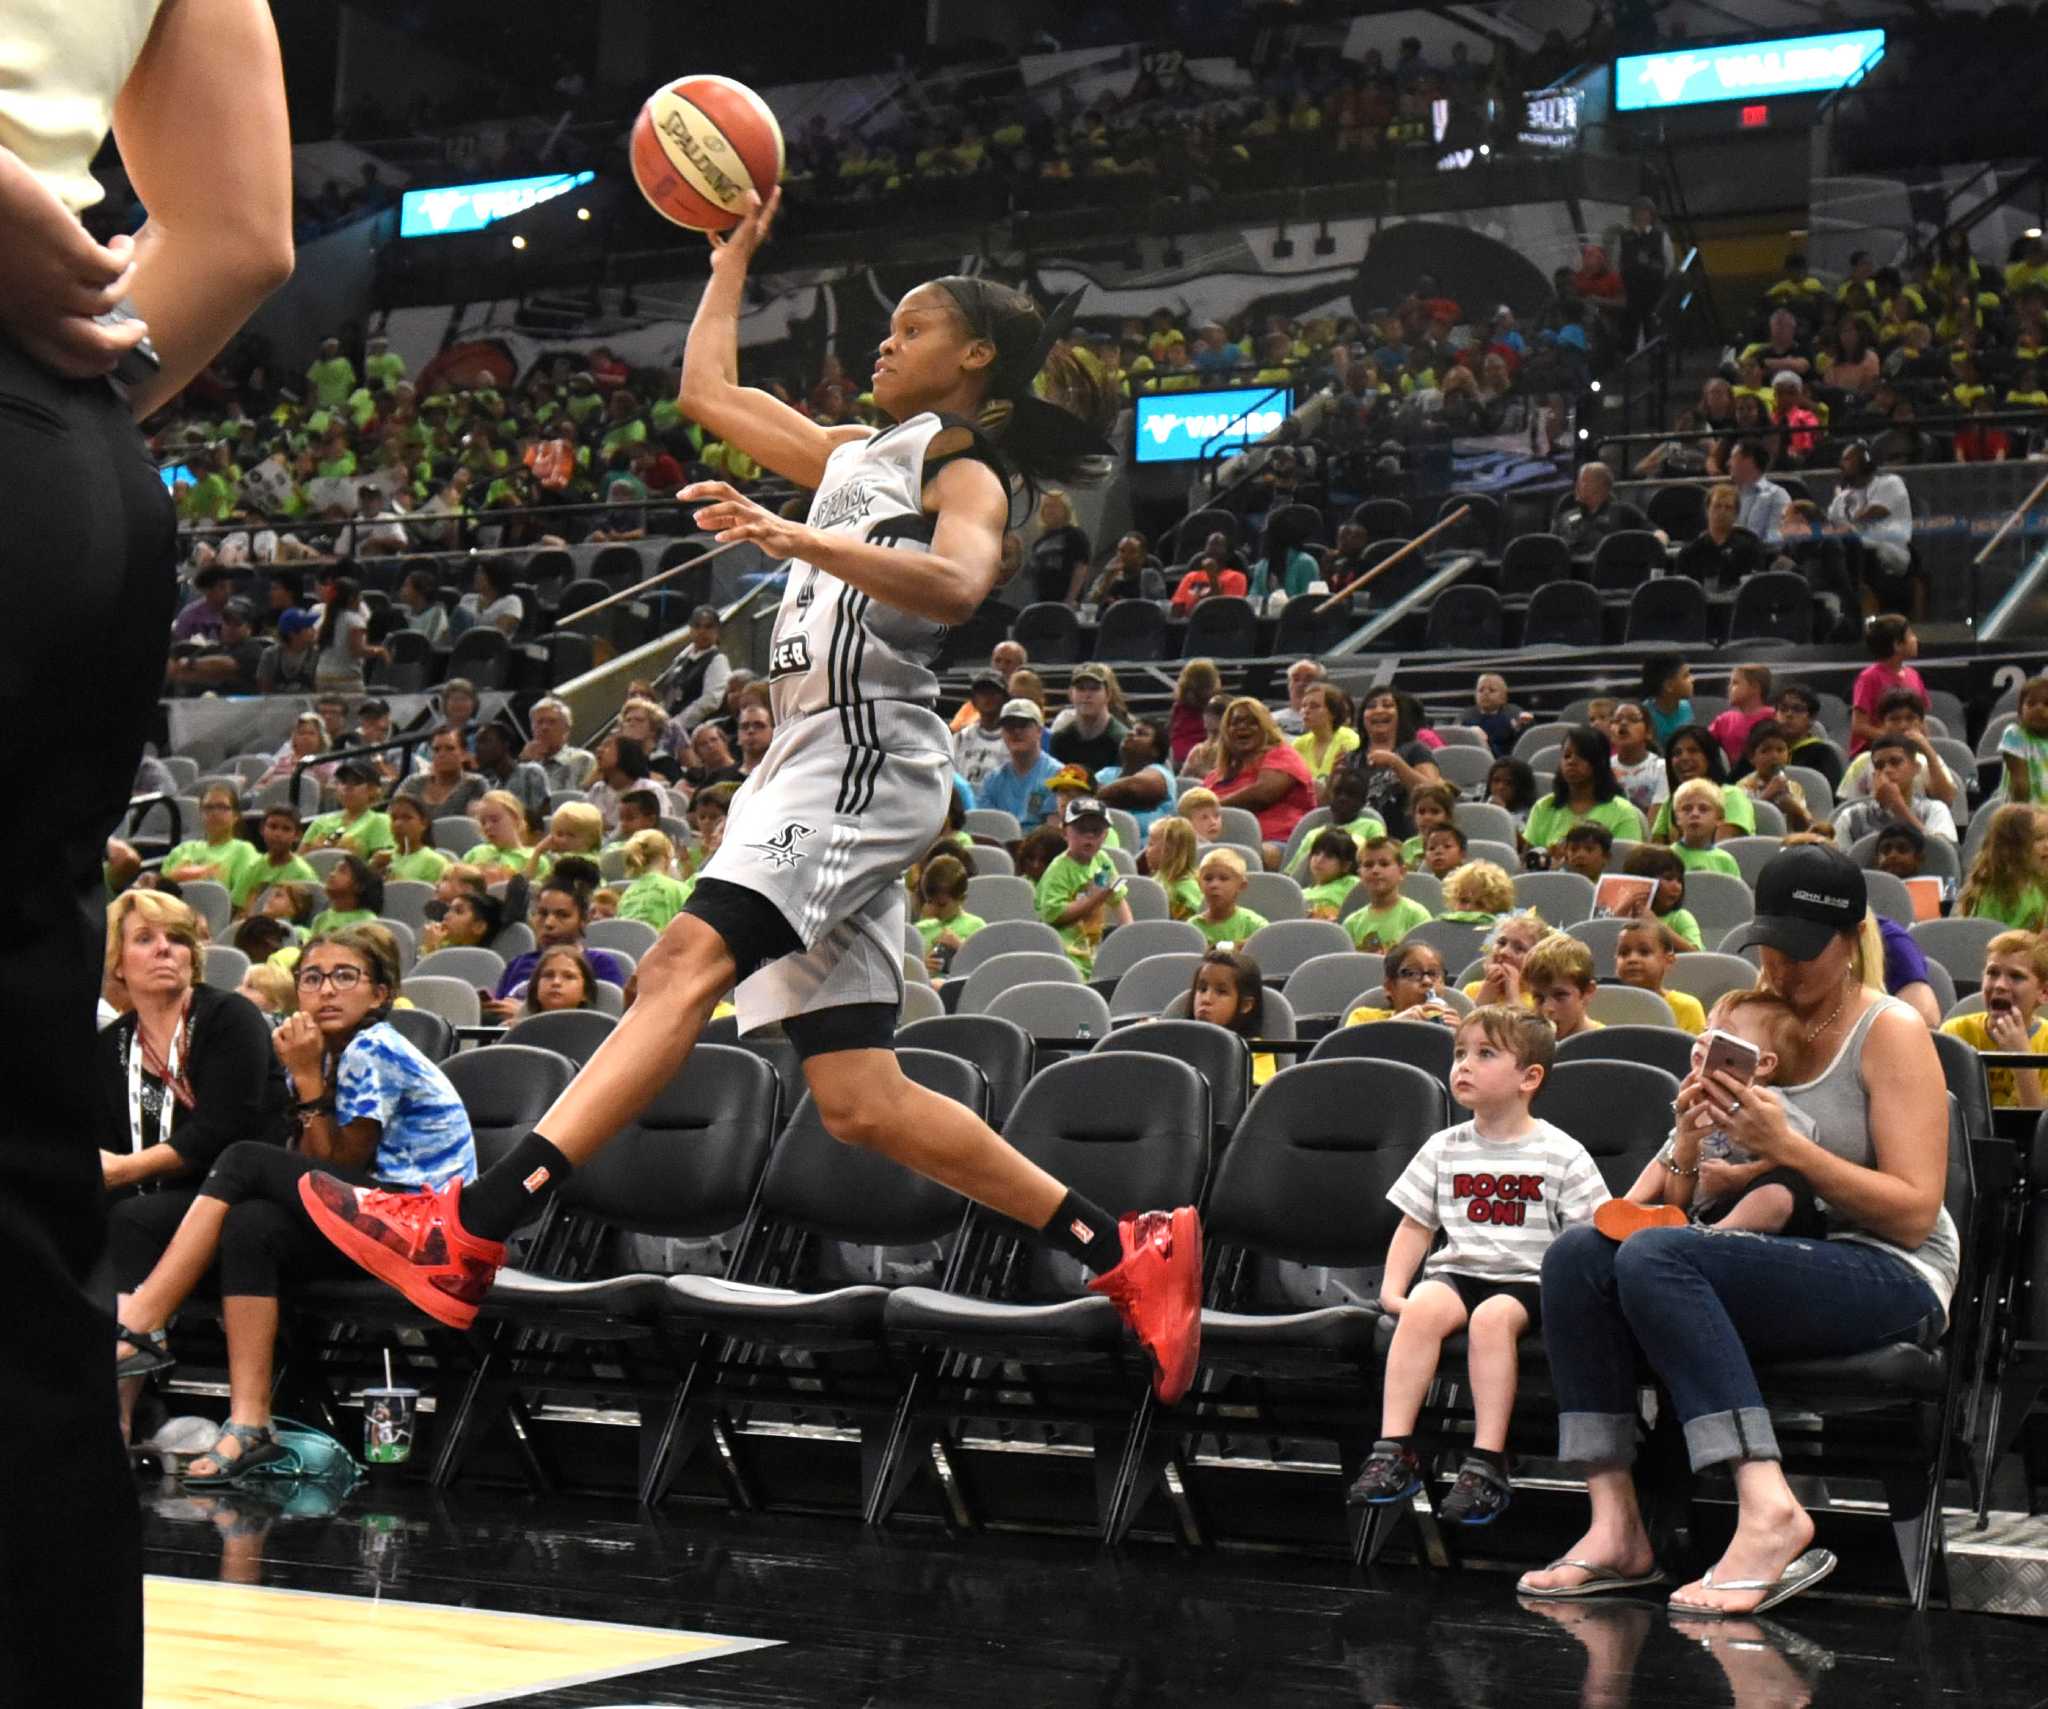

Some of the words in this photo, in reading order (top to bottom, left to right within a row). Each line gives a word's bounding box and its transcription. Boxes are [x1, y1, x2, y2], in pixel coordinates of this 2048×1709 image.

[658, 110, 743, 204] SPALDING
[1453, 1173, 1544, 1202] ROCK
[1467, 1199, 1526, 1227] ON!
